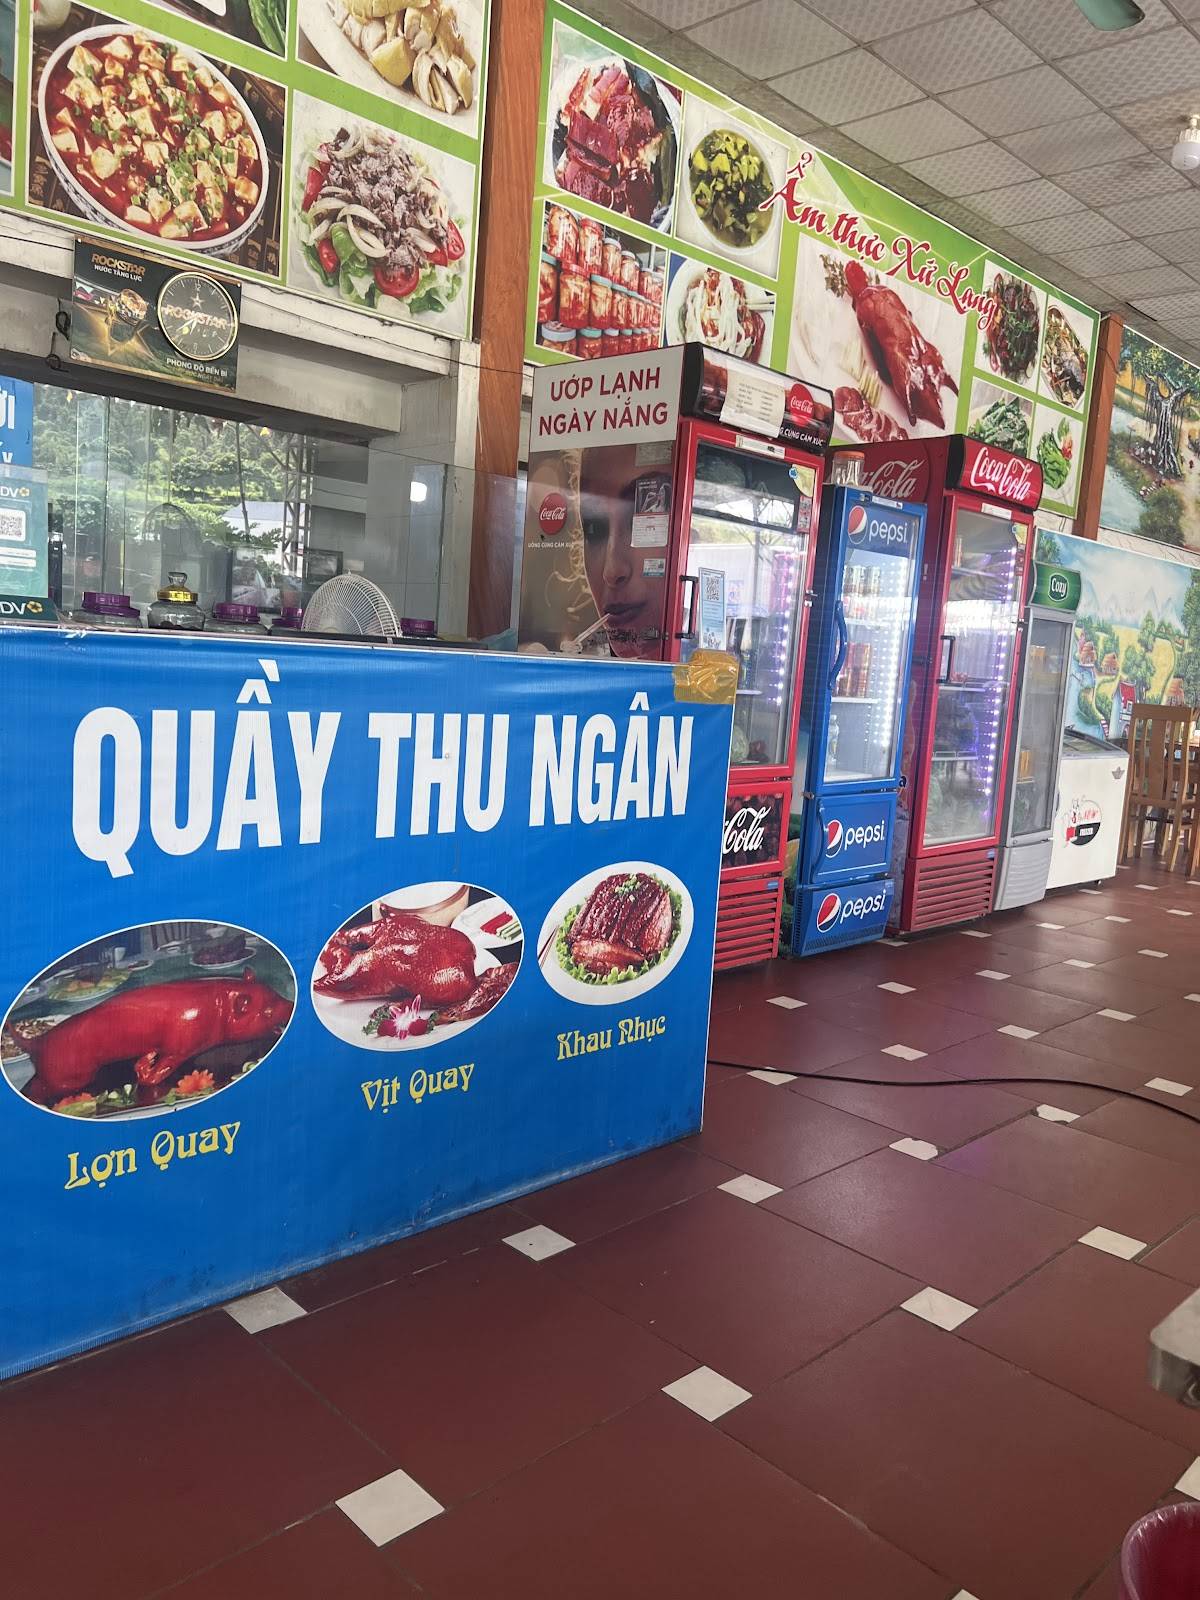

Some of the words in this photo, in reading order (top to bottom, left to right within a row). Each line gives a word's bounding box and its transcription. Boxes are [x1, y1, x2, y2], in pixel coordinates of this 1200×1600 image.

[759, 152, 827, 235] Ẩm
[827, 212, 886, 261] thực
[885, 237, 938, 287] Xứ
[936, 262, 1001, 330] Lạng
[91, 253, 146, 276] ROCKSTAR
[163, 303, 228, 330] ROCKSTAR
[166, 358, 193, 370] PHONG
[550, 374, 593, 401] ƯỚP
[599, 367, 660, 399] LẠNH
[539, 407, 597, 436] NGÀY
[603, 396, 668, 431] NẮNG
[790, 395, 814, 414] Coca-Cola
[970, 446, 1034, 501] Coca-Cola
[0, 486, 19, 498] DV
[540, 506, 567, 521] Coca-Cola
[869, 520, 908, 545] pepsi
[1051, 577, 1068, 593] Cozy
[0, 601, 26, 615] DV
[72, 659, 341, 878] QUẦY
[368, 713, 509, 840] THU
[529, 692, 694, 827] NGÂN
[844, 820, 885, 851] pepsi
[840, 889, 887, 923] pepsi
[557, 1029, 612, 1061] Khau
[618, 1013, 667, 1046] Nhục
[361, 1076, 401, 1114] Vịt
[409, 1063, 475, 1104] Quay
[64, 1147, 138, 1190] Lợn
[151, 1121, 241, 1171] Quay
